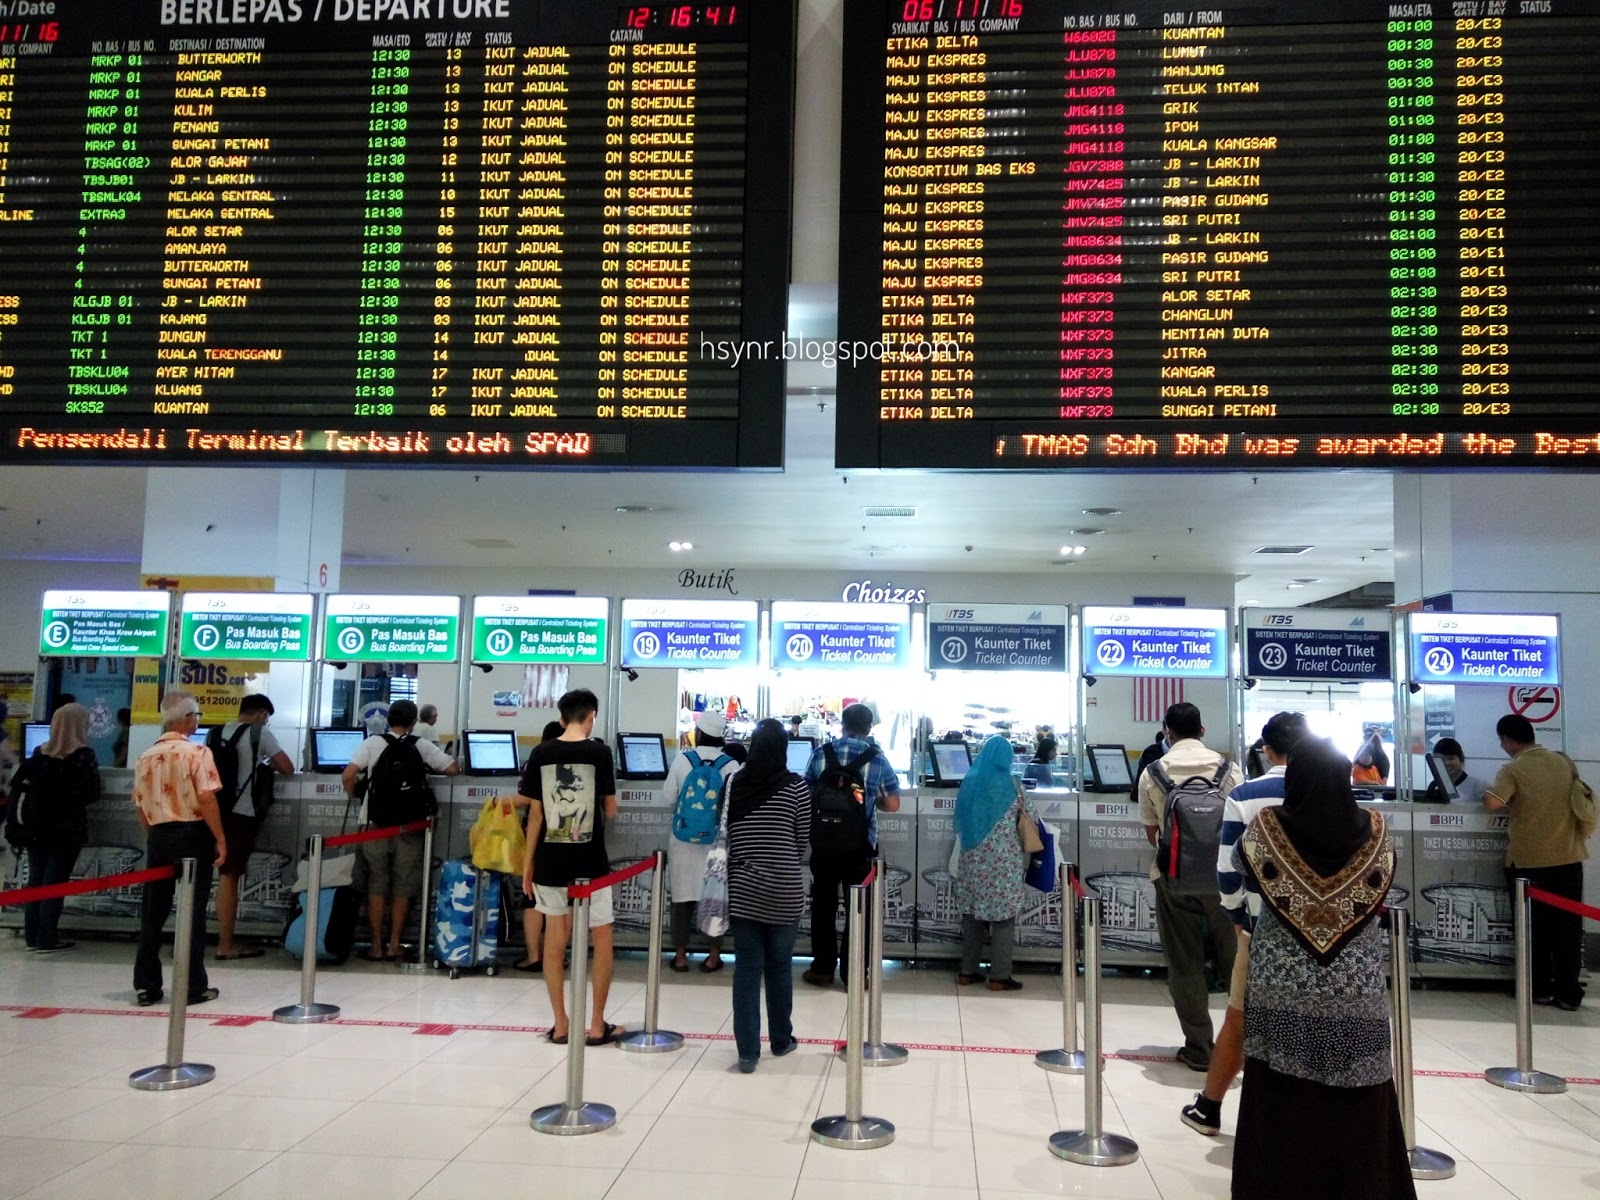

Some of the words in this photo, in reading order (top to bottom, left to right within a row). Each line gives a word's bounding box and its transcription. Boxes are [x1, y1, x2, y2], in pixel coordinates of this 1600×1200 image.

[160, 0, 303, 25] BERLEPAS
[334, 0, 510, 22] DEPARTURE
[1389, 4, 1432, 17] MASA/ETA
[1454, 8, 1477, 16] GATE
[1487, 8, 1505, 16] BAY
[1520, 1, 1552, 14] STATUS
[1063, 16, 1078, 28] NO.
[1079, 15, 1095, 28] BAS
[1105, 14, 1121, 26] BUS
[1124, 13, 1138, 26] NO.
[1163, 13, 1184, 25] DARI
[1197, 11, 1223, 24] FROM
[892, 21, 930, 35] SYARIKAT
[934, 21, 949, 33] BAS
[960, 20, 976, 32] BUS
[979, 18, 1020, 31] COMPANY
[372, 34, 411, 47] MASA/ETD
[485, 32, 512, 45] STATUS
[610, 29, 643, 41] CATATAN
[887, 37, 928, 50] ETIKA
[936, 35, 978, 49] DELTA
[1163, 27, 1224, 40] KUANTAN
[1388, 20, 1432, 32] 00:00
[1456, 18, 1501, 30] 20/E3
[2, 43, 15, 55] BUS
[18, 43, 54, 55] COMPANY
[169, 38, 207, 51] DESTINASI
[216, 37, 265, 50] DESTINATION
[92, 55, 122, 66] MRKP
[128, 55, 142, 66] 01
[178, 52, 260, 64] BUTTERWORTH
[373, 50, 410, 61] 12:30
[447, 49, 461, 59] 13
[485, 47, 515, 59] IKUT
[523, 46, 570, 58] JADUAL
[609, 45, 625, 56] ON
[633, 43, 696, 56] SCHEDULE
[175, 88, 213, 98] KUALA
[221, 87, 266, 97] PERLIS
[1163, 139, 1207, 151] KUALA
[1215, 137, 1277, 150] KANGSAR
[885, 164, 968, 178] KONSORTIUM
[976, 163, 1001, 175] BAS
[1010, 162, 1035, 174] EKS
[80, 209, 125, 220] EXTRA3
[167, 208, 213, 219] MELAKA
[221, 208, 274, 219] SENTRAL
[165, 243, 226, 254] AMANJAYA
[1162, 252, 1206, 264] PASIR
[1215, 251, 1268, 263] GUDANG
[1162, 309, 1233, 321] CHANGLUN
[1061, 329, 1113, 342] WXF373
[1162, 328, 1224, 340] HENTIAN
[1233, 327, 1269, 339] DUTA
[158, 349, 196, 359] KUALA
[204, 349, 282, 360] TERENGGANU
[156, 366, 188, 378] AYER
[194, 367, 234, 378] HITAM
[66, 402, 104, 413] SKS52
[154, 402, 209, 414] KUANTAN
[355, 404, 393, 415] 12:30
[1393, 403, 1439, 415] 02:30
[1463, 403, 1510, 414] 20/E3
[186, 429, 304, 450] Terminal
[325, 430, 429, 451] Terbaik
[446, 432, 511, 452] oleh
[525, 432, 589, 453] SPAD
[1022, 434, 1089, 455] TMAS
[1106, 434, 1158, 455] Sdn
[1176, 433, 1229, 454] Bhd
[1246, 438, 1300, 454] was
[1317, 432, 1444, 454] awarded
[1463, 433, 1517, 454] the
[320, 563, 327, 588] 6
[678, 568, 738, 595] Butik
[842, 580, 926, 603] Choizes
[87, 620, 107, 628] Masuk
[134, 629, 157, 637] Airport
[226, 626, 244, 638] Pas
[247, 626, 279, 639] Masuk
[281, 627, 301, 639] Bas
[520, 630, 539, 643] Pas
[542, 631, 575, 643] Masuk
[577, 632, 597, 644] Bas
[667, 632, 711, 644] Kaunter
[713, 632, 740, 645] Tiket
[82, 636, 104, 644] Boarding
[225, 639, 242, 650] Bus
[242, 639, 278, 653] Boarding
[280, 640, 301, 651] Pass
[975, 637, 1020, 650] Kaunter
[1023, 638, 1051, 650] Tiket
[519, 644, 536, 654] Bus
[537, 644, 574, 657] Boarding
[576, 645, 597, 655] Pass
[667, 646, 697, 659] Ticket
[700, 647, 742, 660] Counter
[1295, 643, 1342, 656] Kaunter
[1345, 644, 1375, 657] Tiket
[1462, 647, 1509, 660] Kaunter
[1512, 648, 1542, 661] Tiket
[975, 652, 1006, 664] Ticket
[1009, 652, 1052, 665] Counter
[1295, 658, 1328, 671] Ticket
[1331, 659, 1376, 672] Counter
[1462, 663, 1495, 676] Ticket
[1498, 663, 1544, 677] Counter
[631, 791, 652, 800] BPH
[1106, 804, 1128, 814] BPH
[1441, 815, 1464, 825] BPH
[1089, 826, 1106, 837] TIKET
[1108, 827, 1116, 837] KE
[1117, 827, 1139, 838] SEMUA
[1423, 837, 1441, 848] TIKET
[1443, 837, 1452, 848] KE
[1452, 838, 1476, 849] SEMUA
